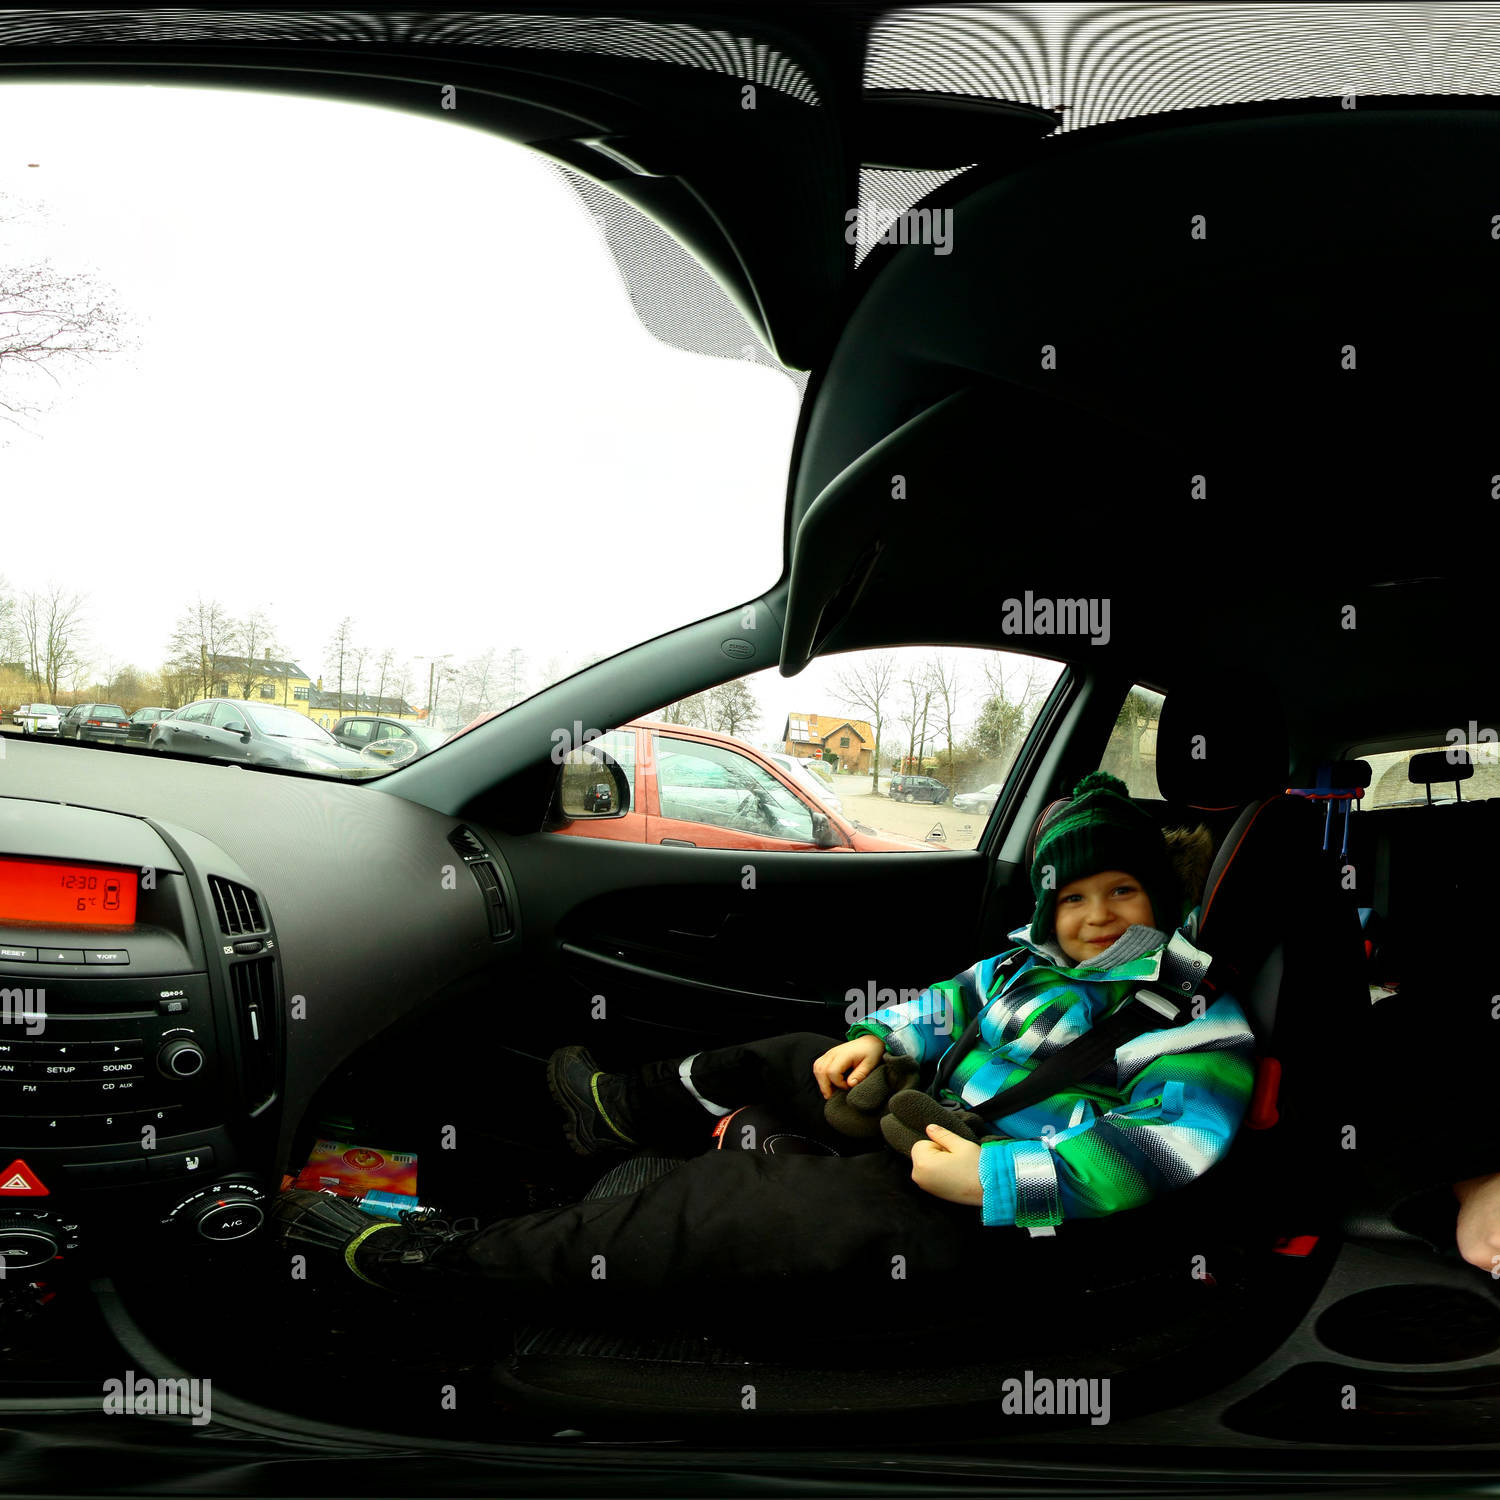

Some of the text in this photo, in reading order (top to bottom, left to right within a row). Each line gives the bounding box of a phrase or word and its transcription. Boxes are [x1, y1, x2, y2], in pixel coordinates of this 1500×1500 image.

[60, 875, 97, 890] 12:30
[1, 949, 27, 958] RESET
[46, 1066, 76, 1074] SETUP
[102, 1063, 133, 1073] SOUND
[22, 1085, 37, 1093] FM
[102, 1082, 115, 1091] CD
[157, 1111, 164, 1119] 6
[49, 1120, 57, 1128] 4
[106, 1117, 113, 1125] 5
[221, 1220, 243, 1229] A/C
